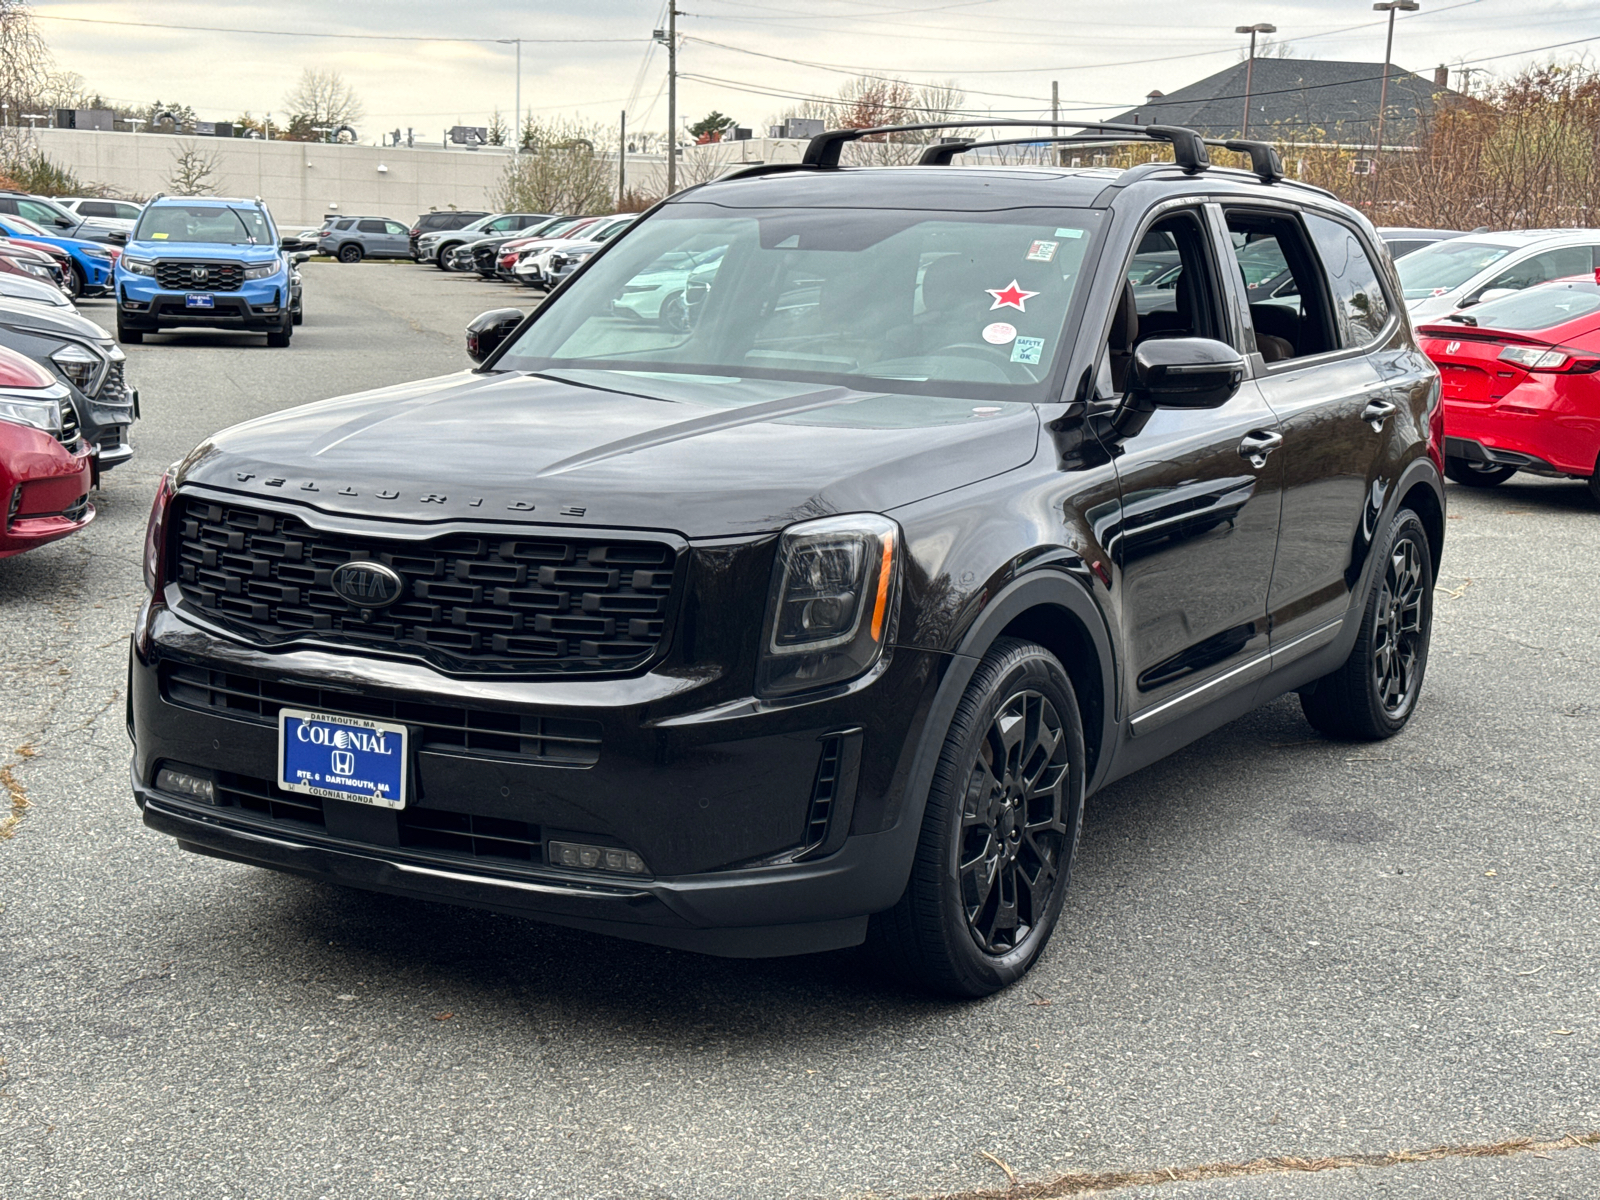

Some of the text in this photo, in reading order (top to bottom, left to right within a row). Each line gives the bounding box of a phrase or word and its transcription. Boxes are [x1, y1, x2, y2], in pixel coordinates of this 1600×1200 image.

[236, 472, 587, 517] TELLURIDE
[341, 569, 388, 599] KIA
[296, 724, 392, 755] COLONIAL
[297, 770, 390, 792] RTE. 6 DARTMOUTH, MA
[308, 787, 374, 804] COLONIAL HONDA
